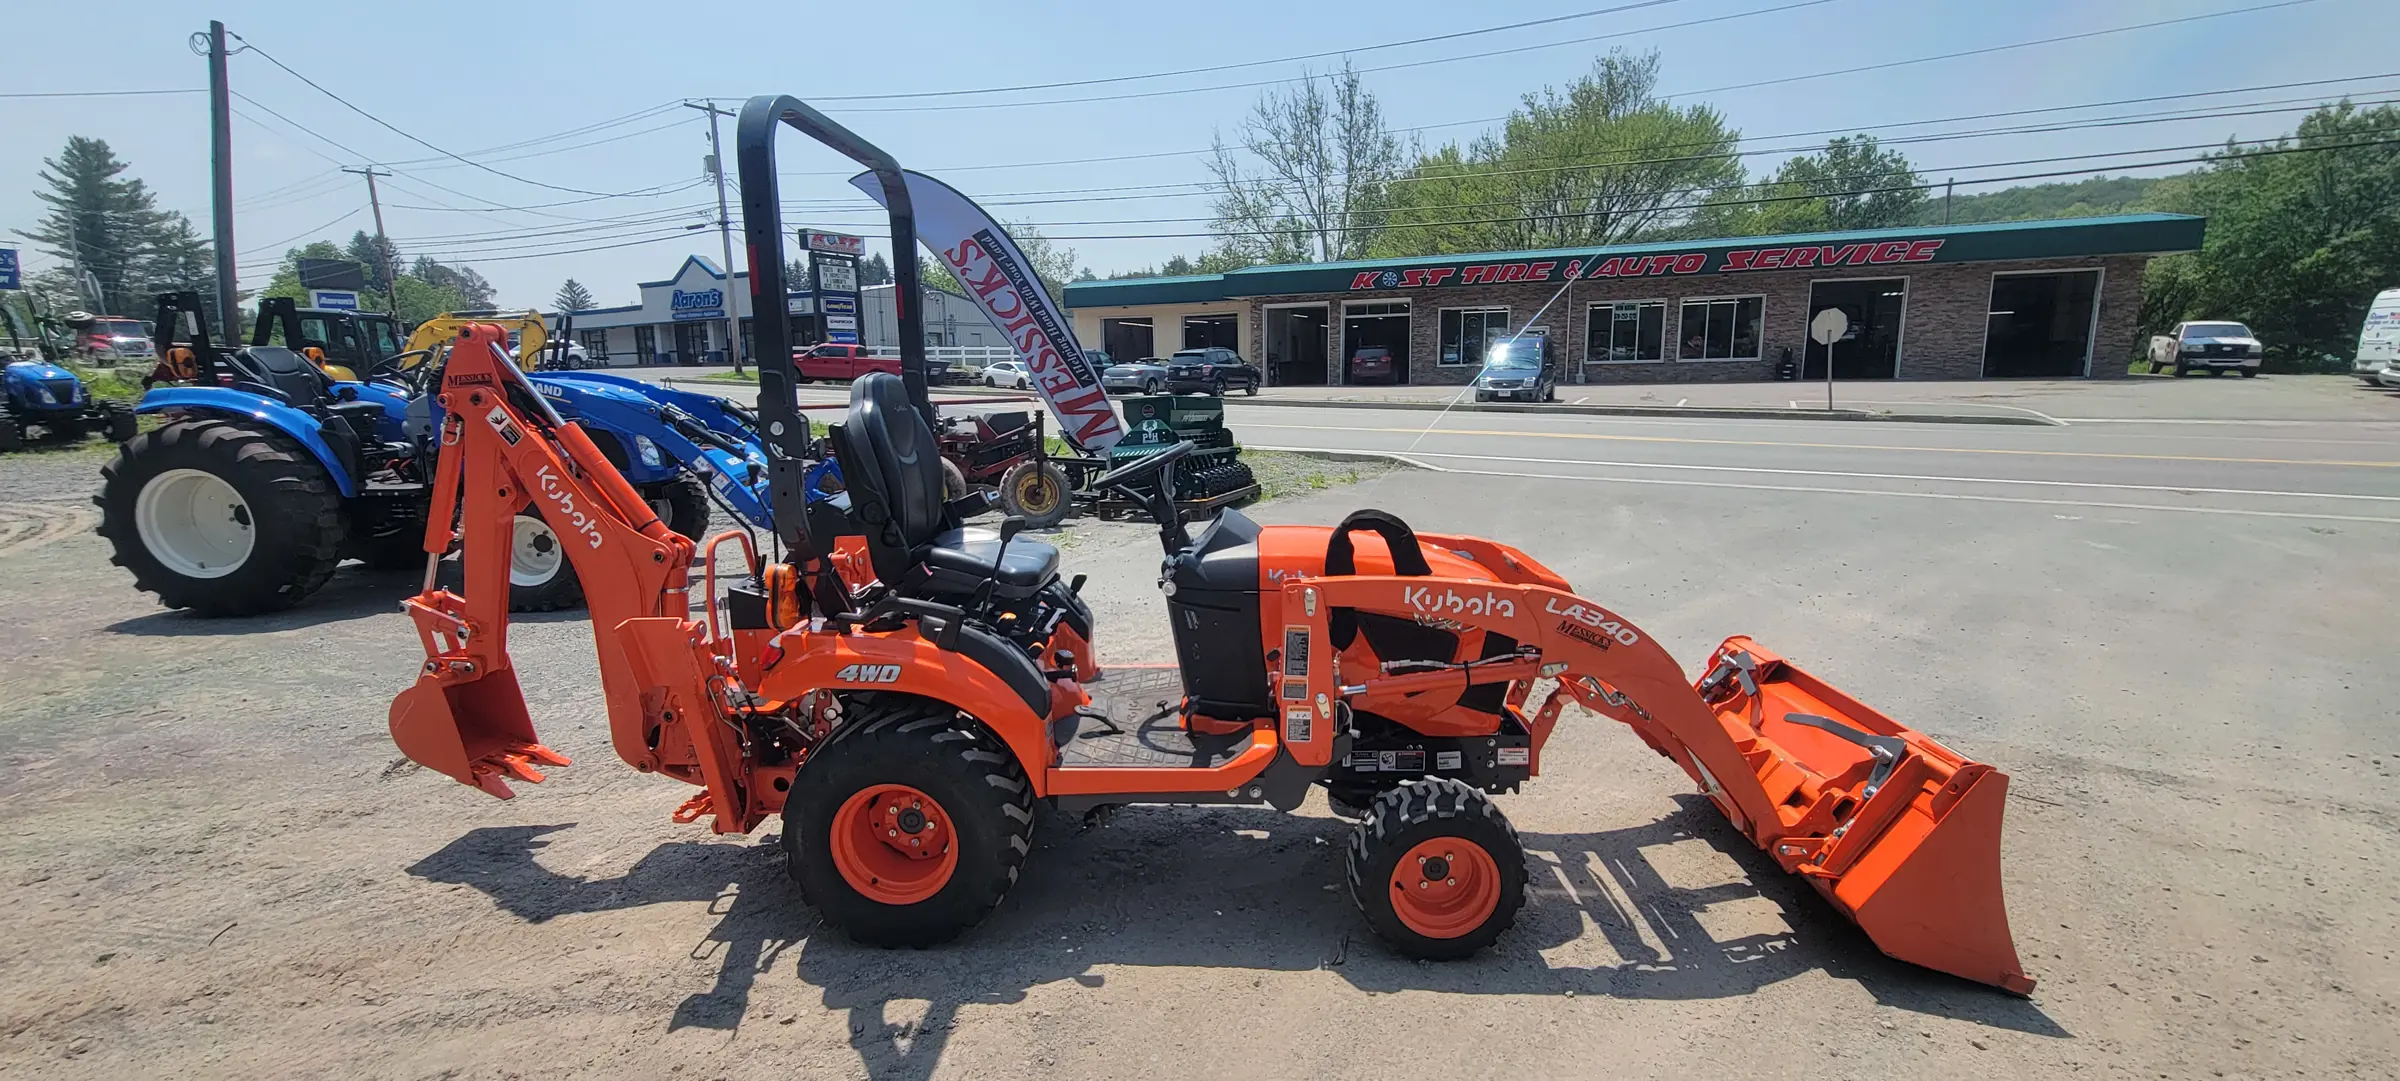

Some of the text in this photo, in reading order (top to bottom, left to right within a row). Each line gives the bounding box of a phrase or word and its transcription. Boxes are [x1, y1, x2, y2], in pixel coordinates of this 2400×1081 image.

[981, 235, 1008, 262] Land
[1461, 261, 1557, 285] TIRE
[1563, 259, 1582, 279] &
[1588, 253, 1707, 279] AUTO
[1719, 239, 1945, 272] SERVICE
[1005, 262, 1024, 285] Your
[671, 288, 722, 310] Aaron's
[1021, 285, 1041, 310] With
[1036, 309, 1060, 337] Hand
[944, 239, 1119, 445] MESSICK'S
[1057, 336, 1086, 374] Helping
[536, 465, 603, 549] Kubota
[1404, 586, 1515, 617] Kubota
[1545, 597, 1639, 646] LA340
[836, 664, 902, 682] 4WD
